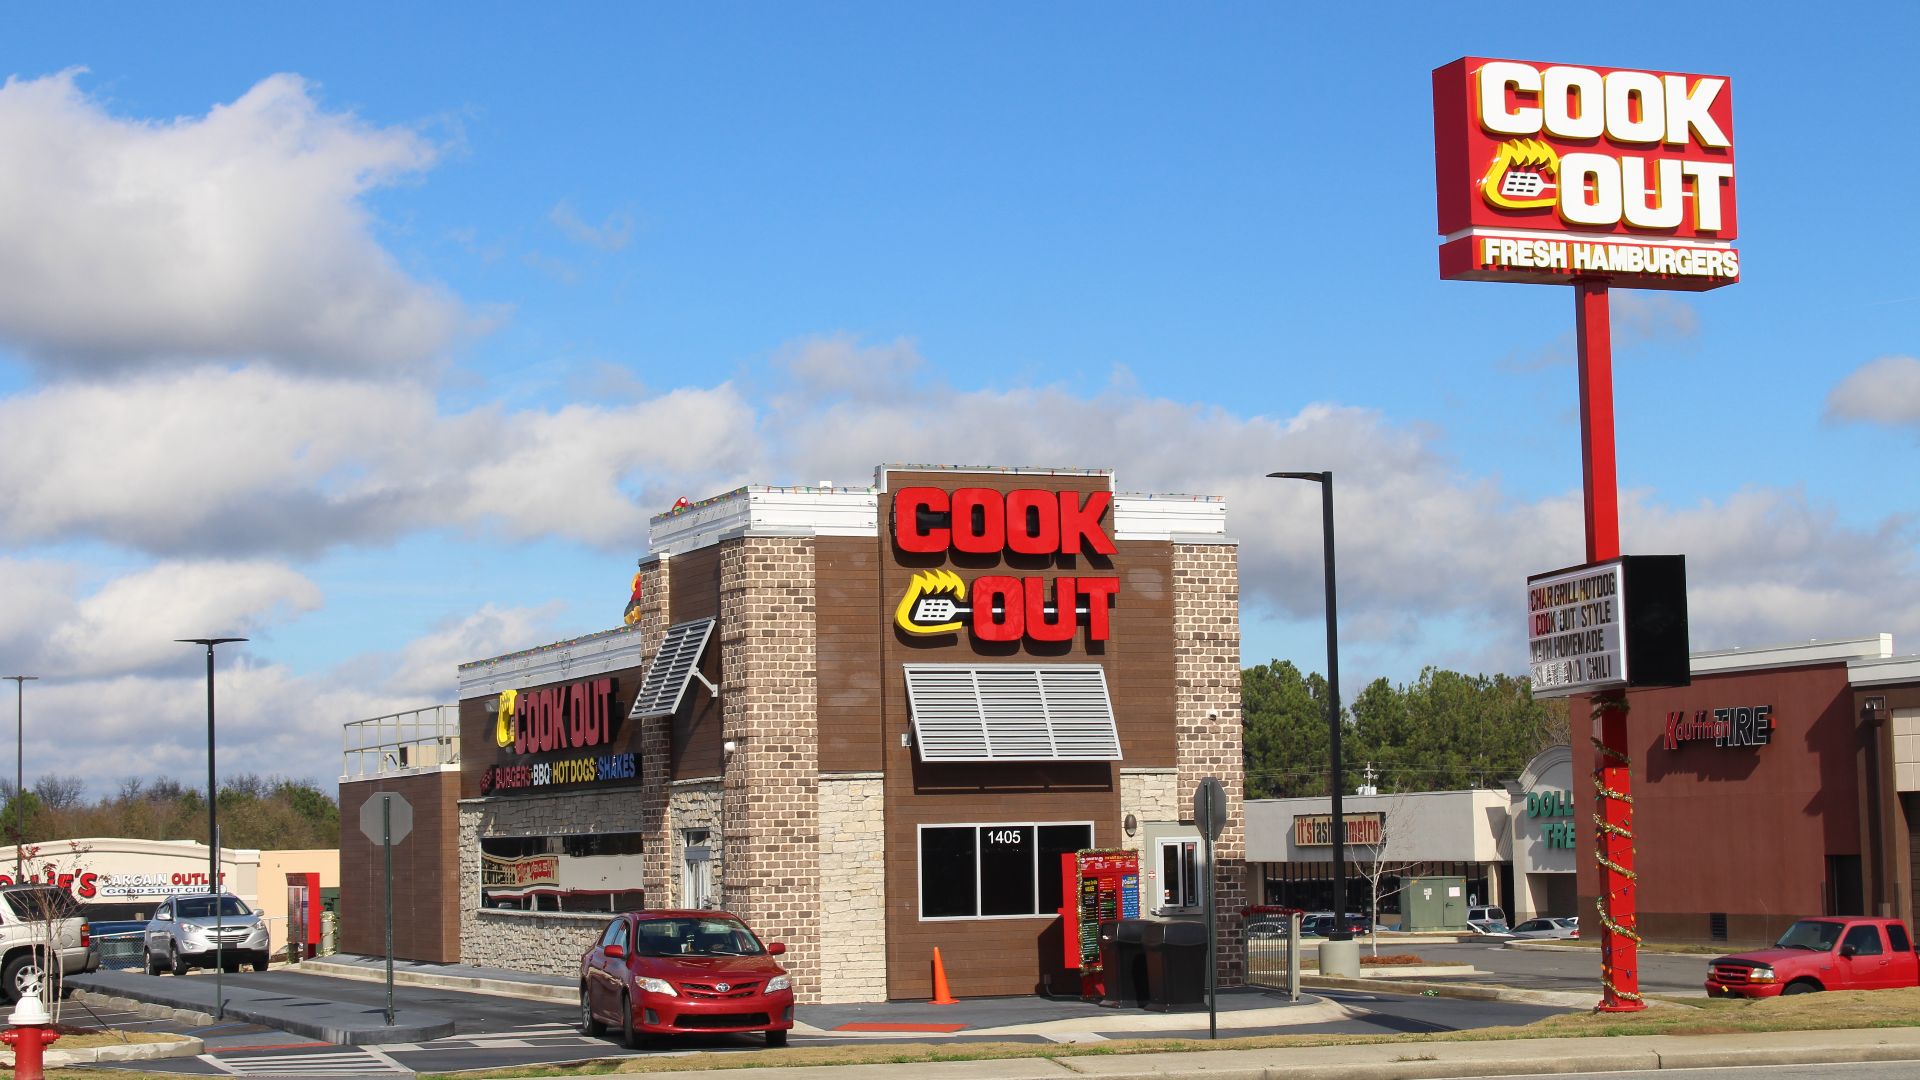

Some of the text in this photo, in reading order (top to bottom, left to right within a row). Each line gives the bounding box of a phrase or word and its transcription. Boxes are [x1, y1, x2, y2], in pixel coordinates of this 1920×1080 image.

[1477, 62, 1732, 148] COOK
[1559, 152, 1734, 231] OUT
[1482, 238, 1739, 278] FRESH HAMBURGERS
[895, 486, 1119, 554] COOK
[972, 576, 1120, 641] OUT
[1530, 585, 1553, 611] CHAR
[1554, 580, 1579, 606] GRILL
[1535, 600, 1611, 636] COOK OUT STYLE
[1530, 629, 1604, 663] WITH HOMEMADE
[1585, 655, 1611, 680] CHILI
[514, 678, 612, 755] COOK OUT
[1664, 705, 1768, 749] Kauffman TIRE
[495, 765, 531, 789] BURGERS
[533, 763, 550, 786] BBQ
[552, 760, 569, 784] HOT
[570, 756, 595, 783] DOGS
[598, 753, 635, 780] SHAKES
[1526, 790, 1574, 817] DOLL
[988, 831, 1020, 844] 1405
[1312, 817, 1348, 843] fashn
[1541, 822, 1576, 848] TRE
[102, 873, 167, 887] BARGAIN
[171, 873, 226, 886] OUTLT
